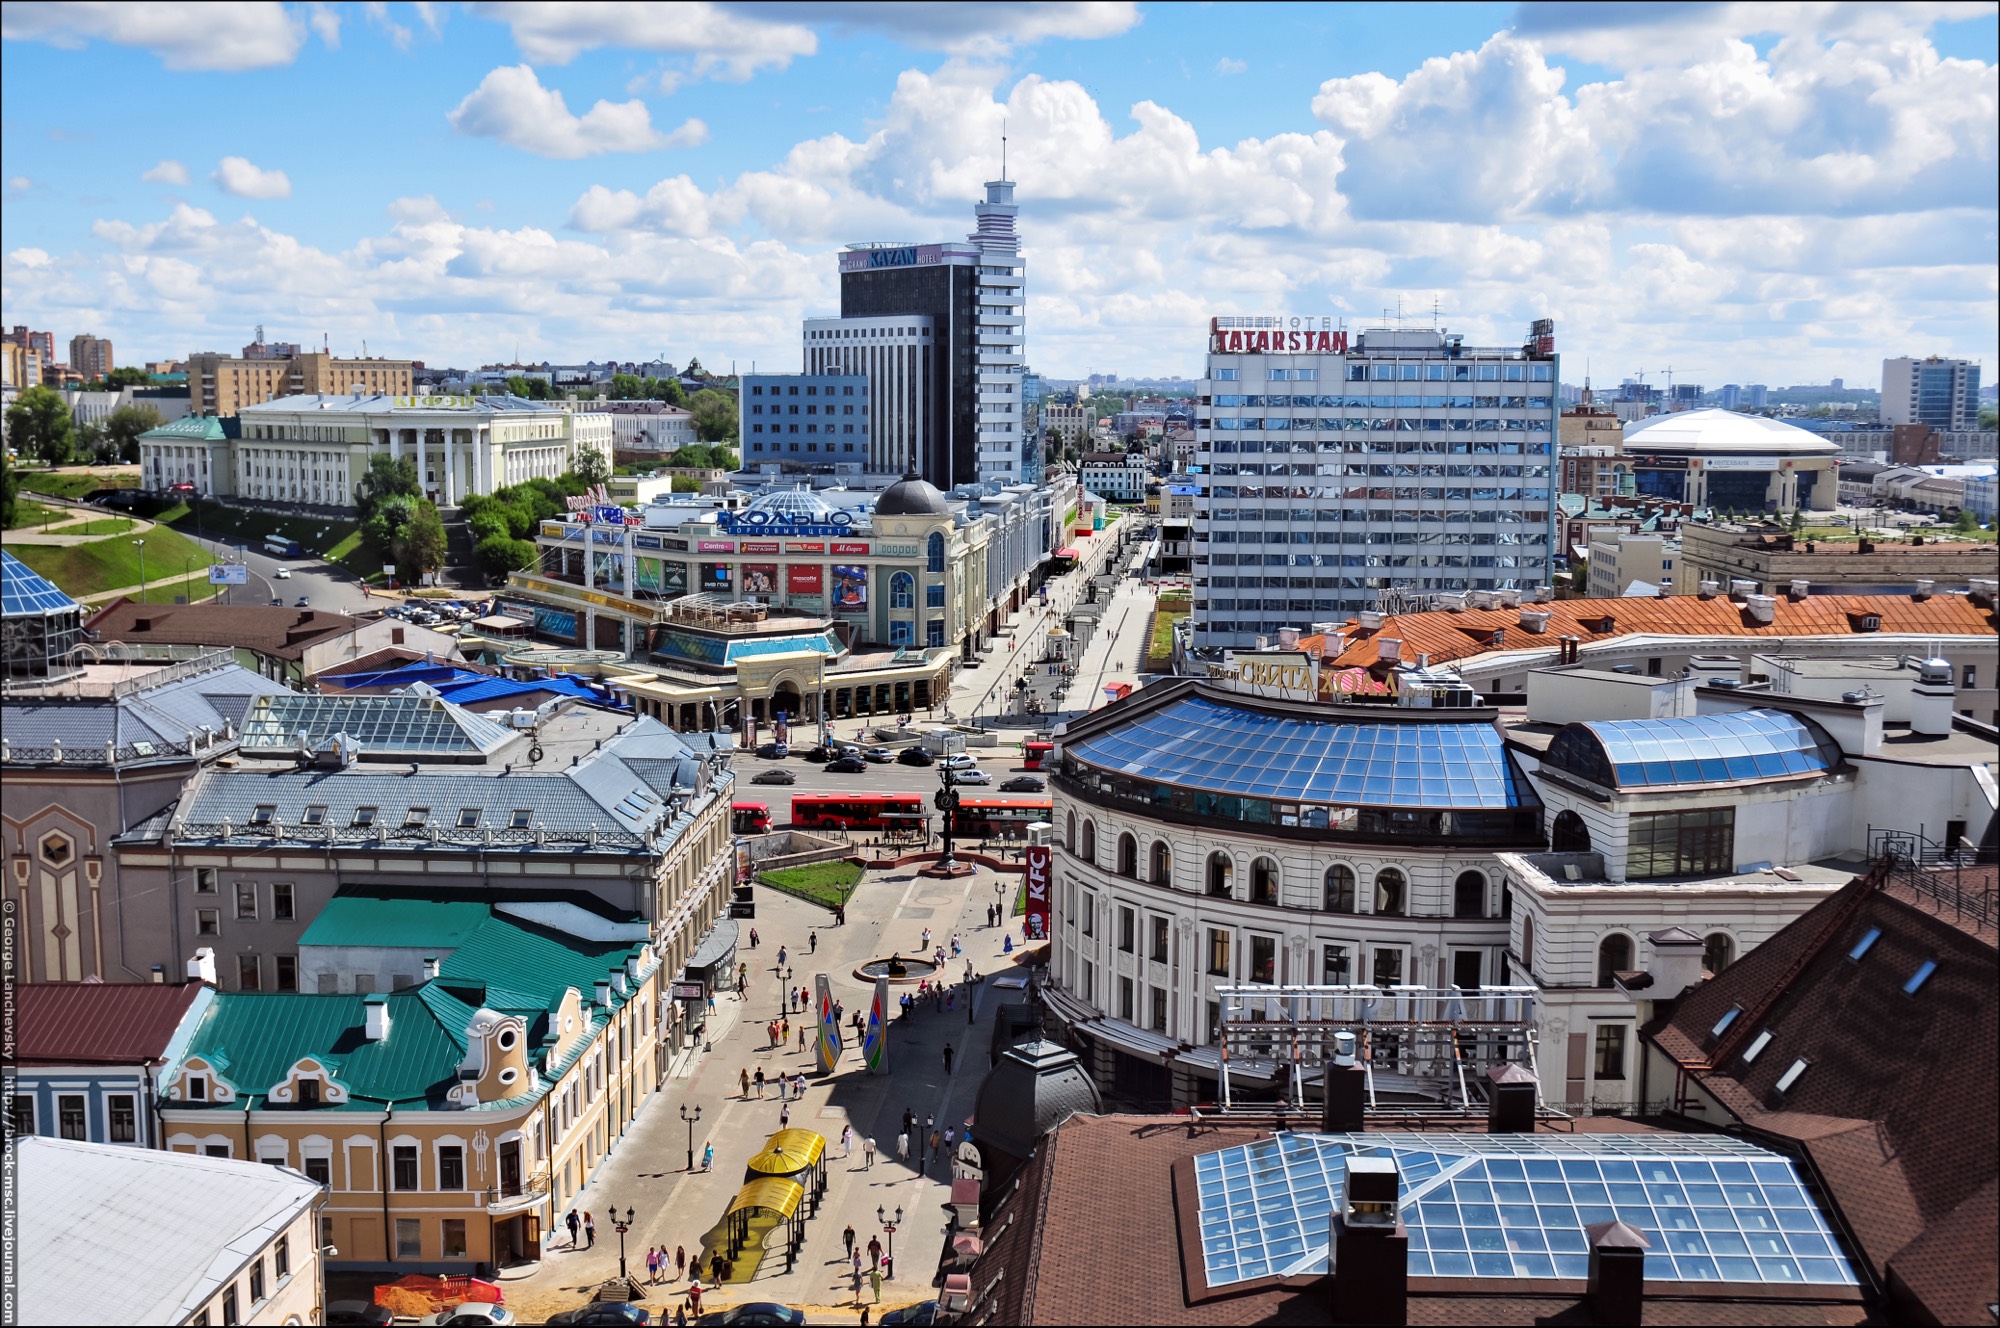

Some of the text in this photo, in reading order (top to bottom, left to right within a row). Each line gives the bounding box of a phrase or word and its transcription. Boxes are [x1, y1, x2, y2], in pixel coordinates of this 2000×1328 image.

[848, 248, 937, 270] GRAND KAZAN HOTEL
[1273, 316, 1348, 329] HOTEL
[1216, 330, 1348, 352] TATARSTAN
[728, 510, 853, 526] КОЛЬЦО
[728, 526, 852, 536] ТОРГОВЫЙ ЦЕНТР
[1239, 660, 1316, 692] СВИТА
[1320, 670, 1399, 697] ХОЛЛ
[1029, 852, 1046, 902] KFC
